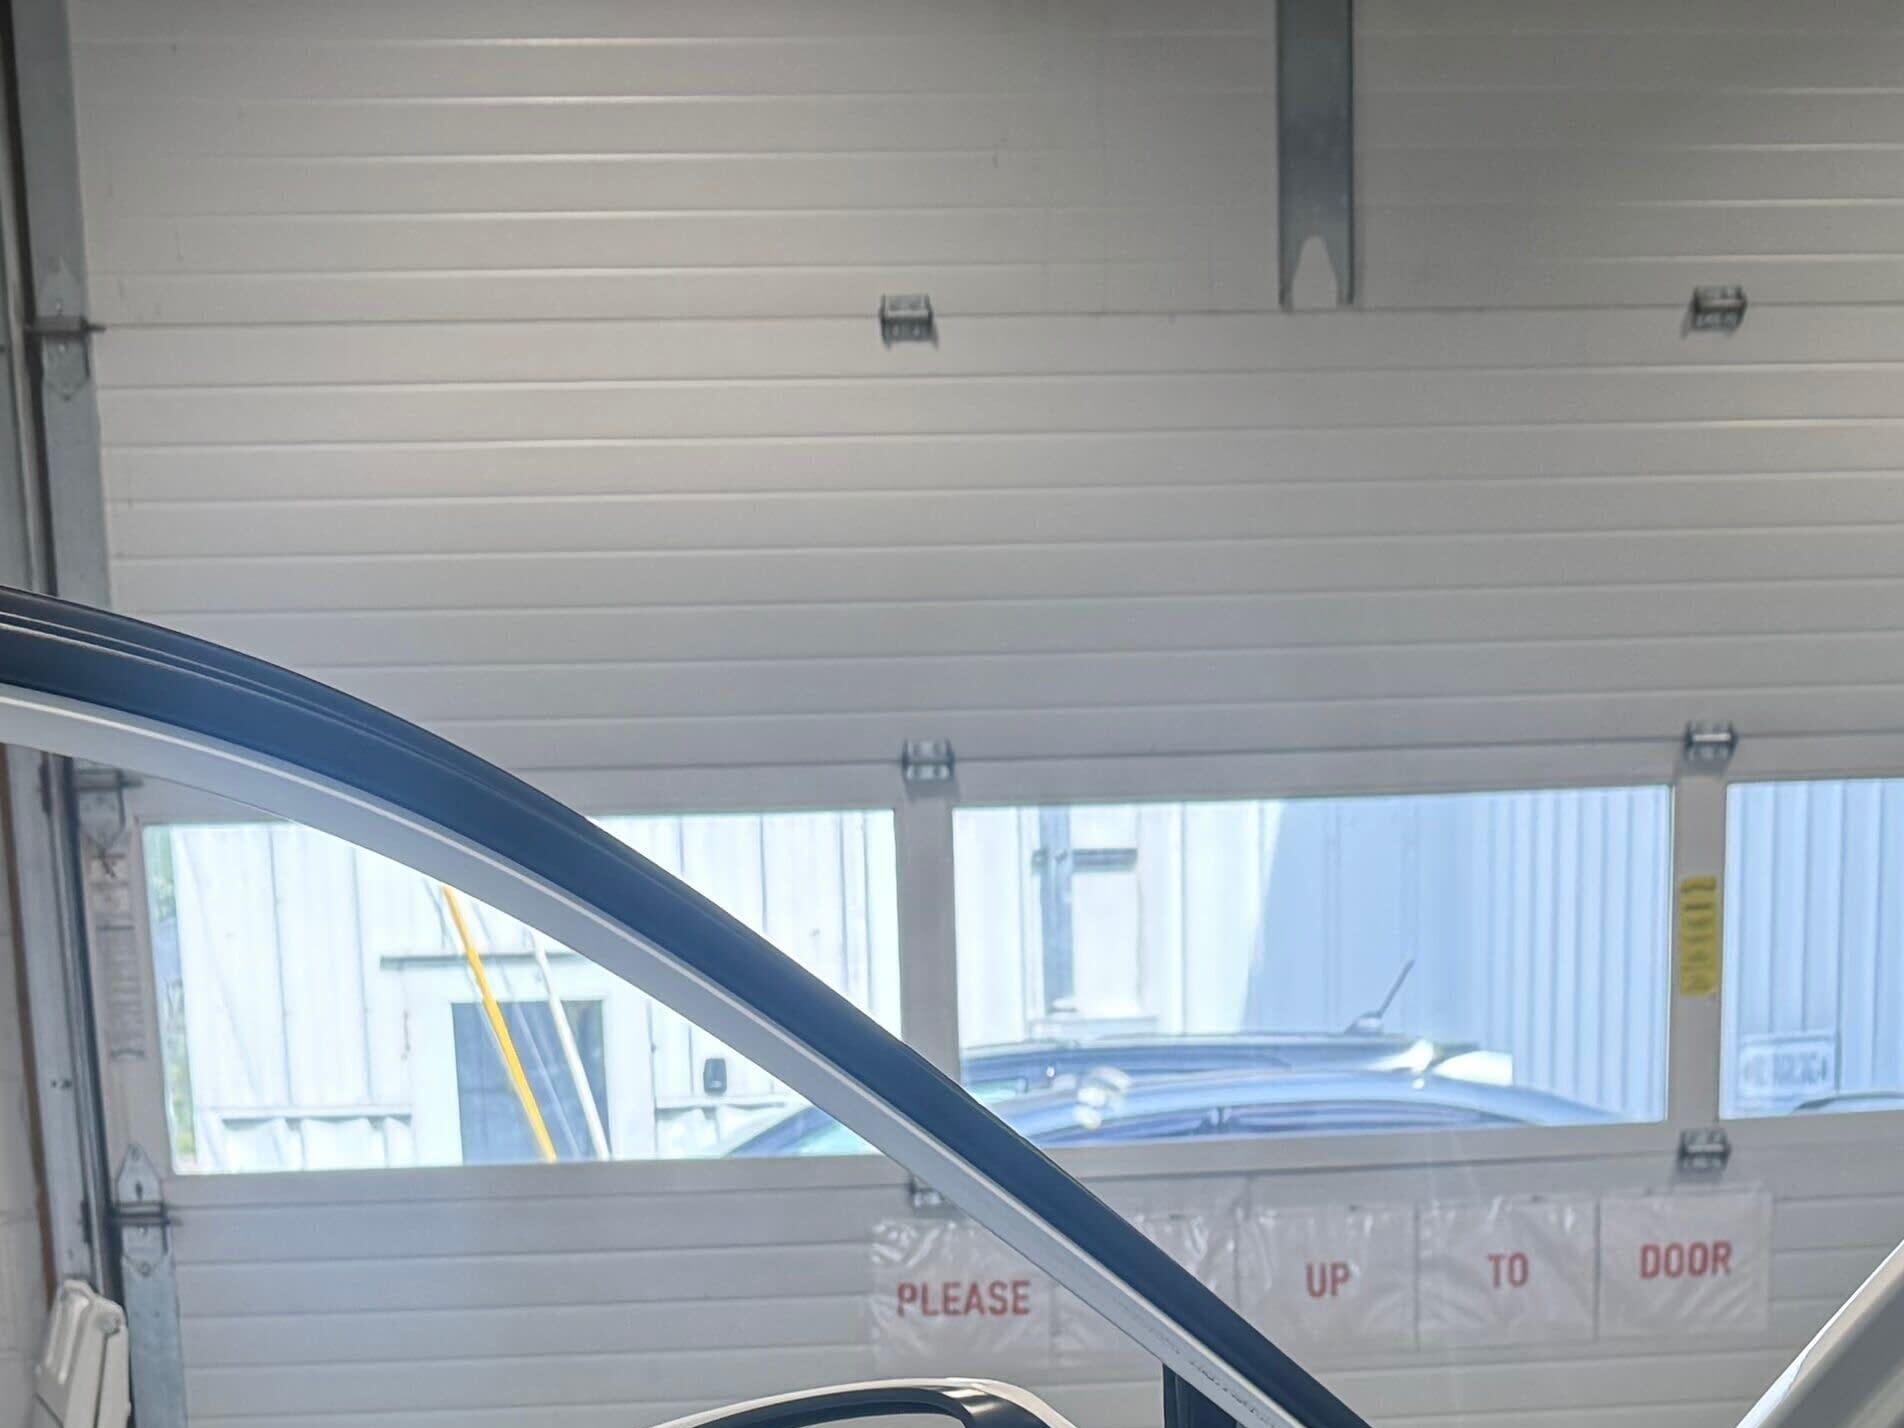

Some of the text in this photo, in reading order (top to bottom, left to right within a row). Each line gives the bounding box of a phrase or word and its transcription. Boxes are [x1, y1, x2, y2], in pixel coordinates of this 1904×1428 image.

[896, 1239, 1733, 1319] PLEASE UP TO DOOR
